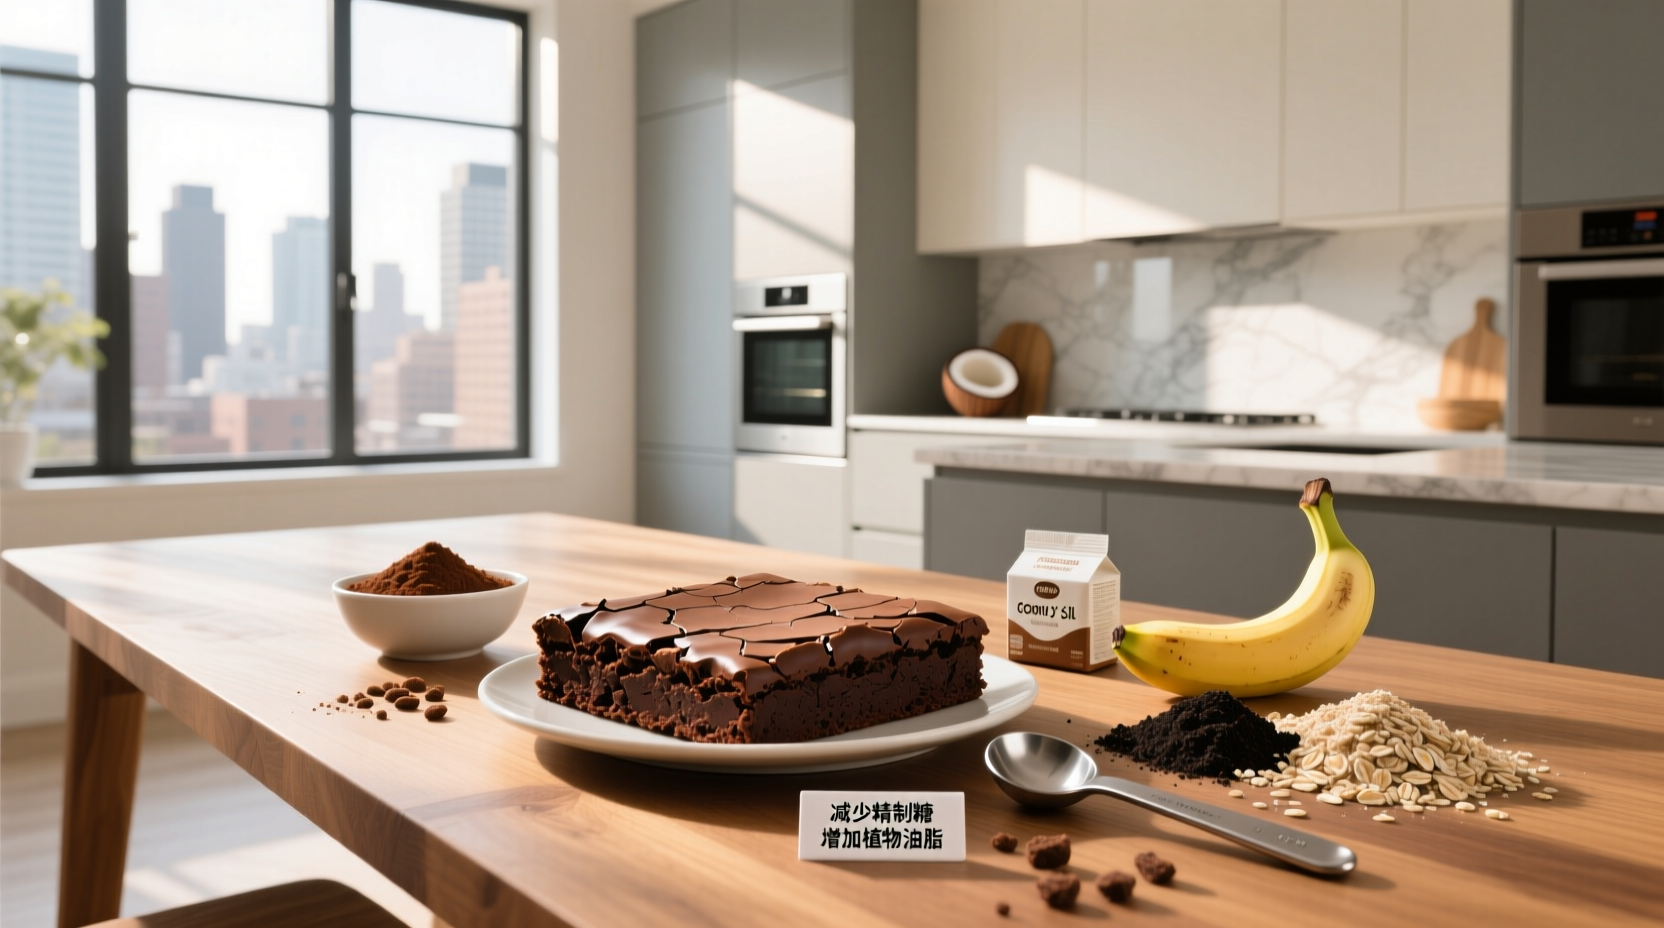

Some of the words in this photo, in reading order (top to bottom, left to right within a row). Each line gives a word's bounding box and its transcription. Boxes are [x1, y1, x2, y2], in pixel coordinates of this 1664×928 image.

[830, 801, 934, 824] 减少精制糖
[820, 827, 943, 850] 增加植物油脂
